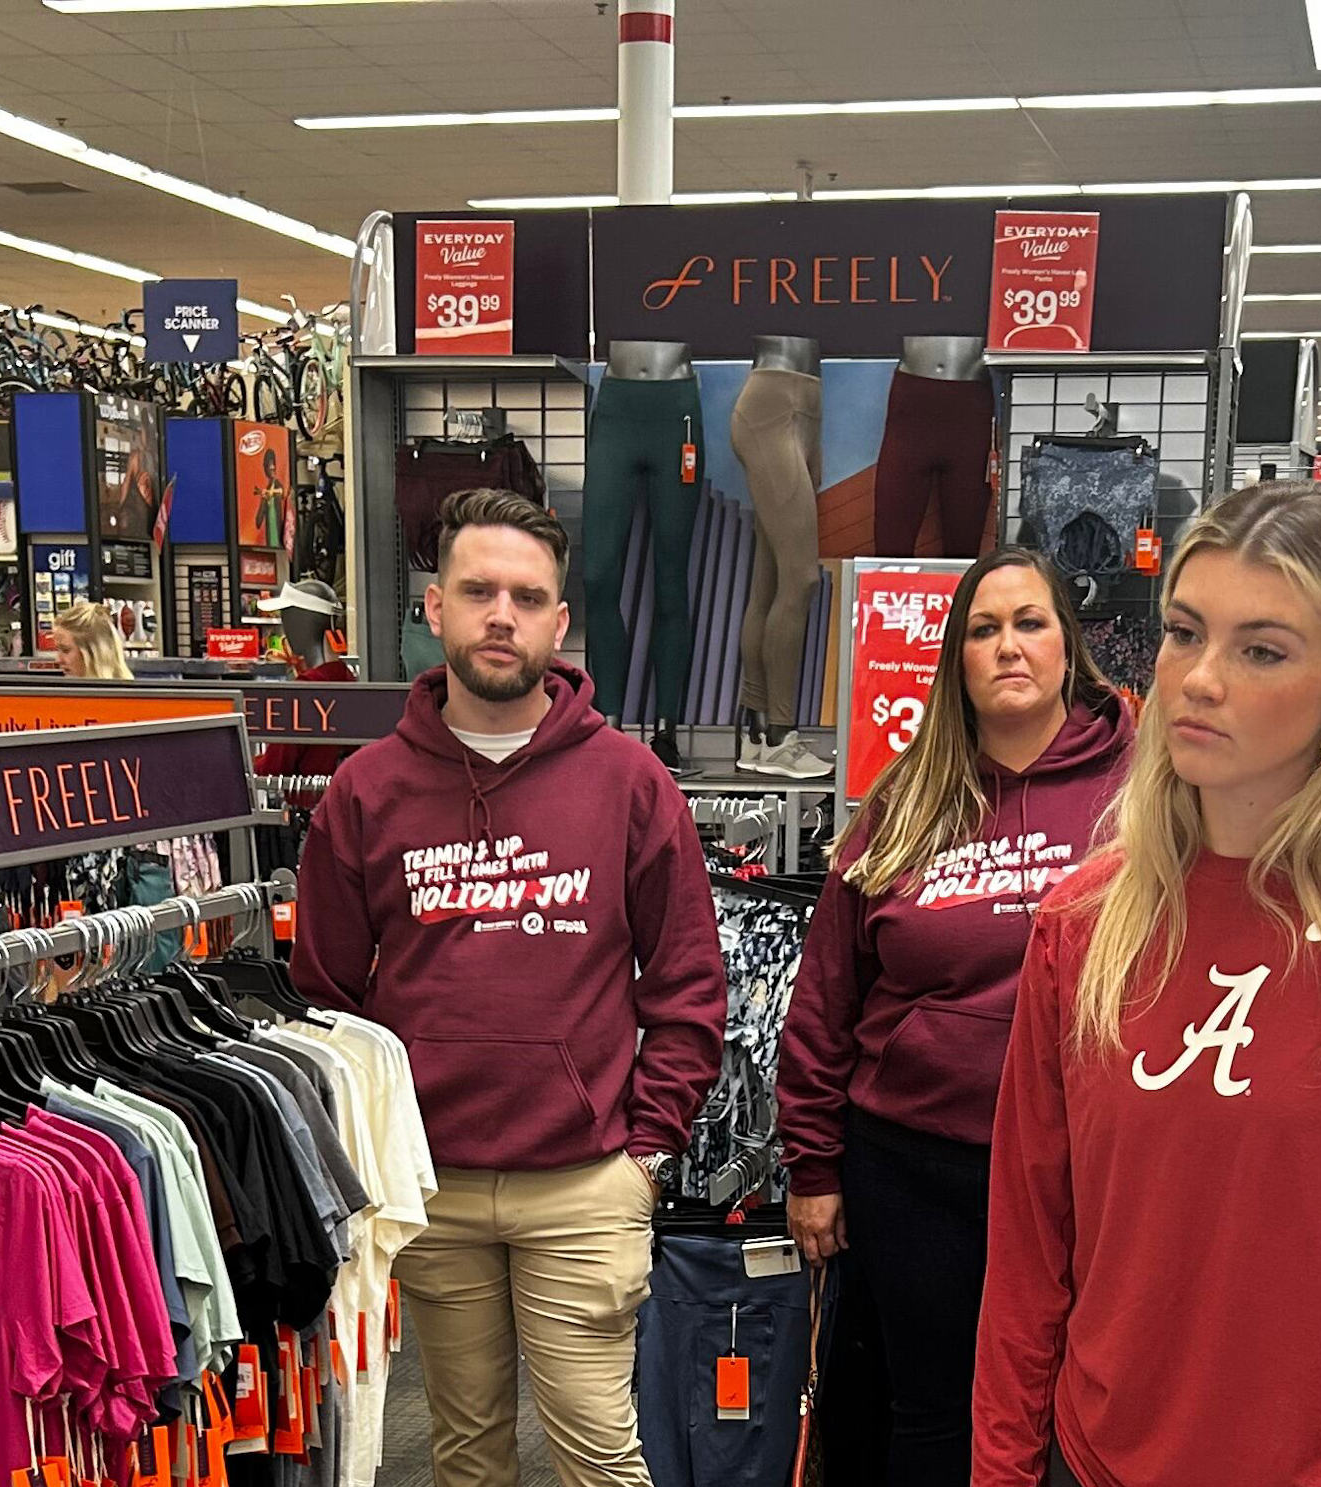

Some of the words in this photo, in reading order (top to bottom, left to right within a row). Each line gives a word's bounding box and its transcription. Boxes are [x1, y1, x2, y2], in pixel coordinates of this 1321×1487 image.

[423, 233, 504, 244] EVERYDAY
[1003, 226, 1090, 237] EVERYDAY
[440, 245, 486, 264] Value
[1020, 238, 1070, 258] Value
[733, 254, 953, 305] FREELY
[174, 305, 208, 318] PRICE
[164, 317, 219, 331] SCANNER
[48, 549, 76, 571] gift
[3, 757, 143, 837] FREELY
[495, 835, 525, 858] UP
[404, 871, 421, 887] TO
[424, 865, 456, 884] FILL
[512, 850, 549, 872] WITH
[410, 879, 527, 917] HOLIDAY
[535, 866, 592, 908] JOY
[1131, 963, 1272, 1097] A
